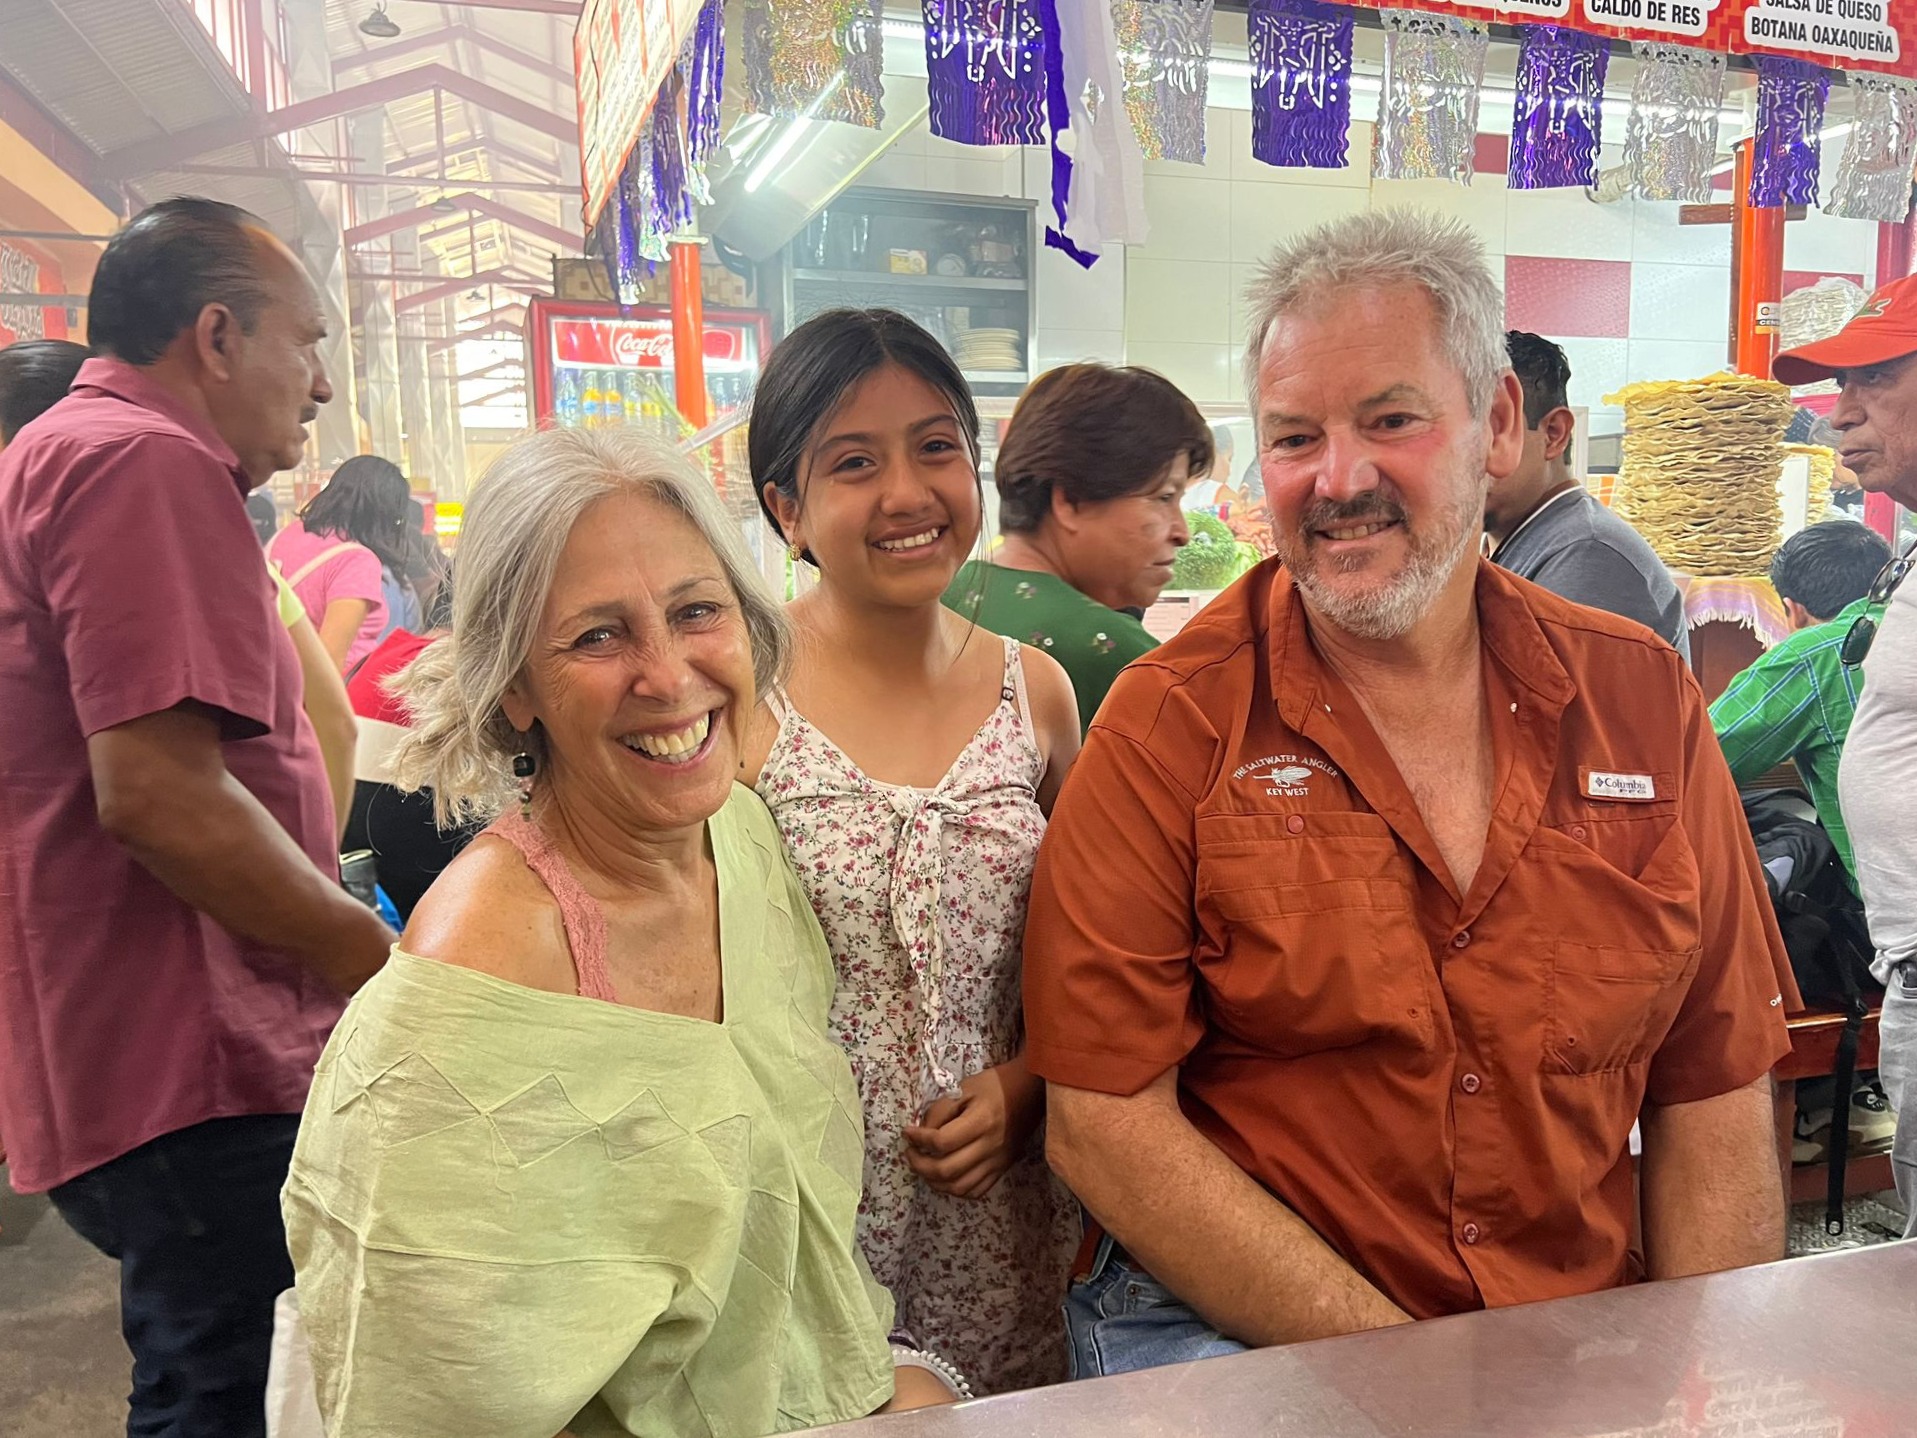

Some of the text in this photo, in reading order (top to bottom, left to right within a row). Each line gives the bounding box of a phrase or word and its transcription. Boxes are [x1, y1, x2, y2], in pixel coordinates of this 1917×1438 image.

[1591, 0, 1700, 26] CALDO DE RES
[1816, 0, 1833, 15] DE
[1838, 0, 1881, 22] QUESO
[1751, 16, 1893, 53] BOTANA OAXAQUEÑA
[615, 332, 674, 356] Coca-Col
[1233, 755, 1338, 780] THE SALTWATER ANGLER
[1266, 787, 1309, 796] KEY WEST
[1604, 777, 1646, 789] Columbia
